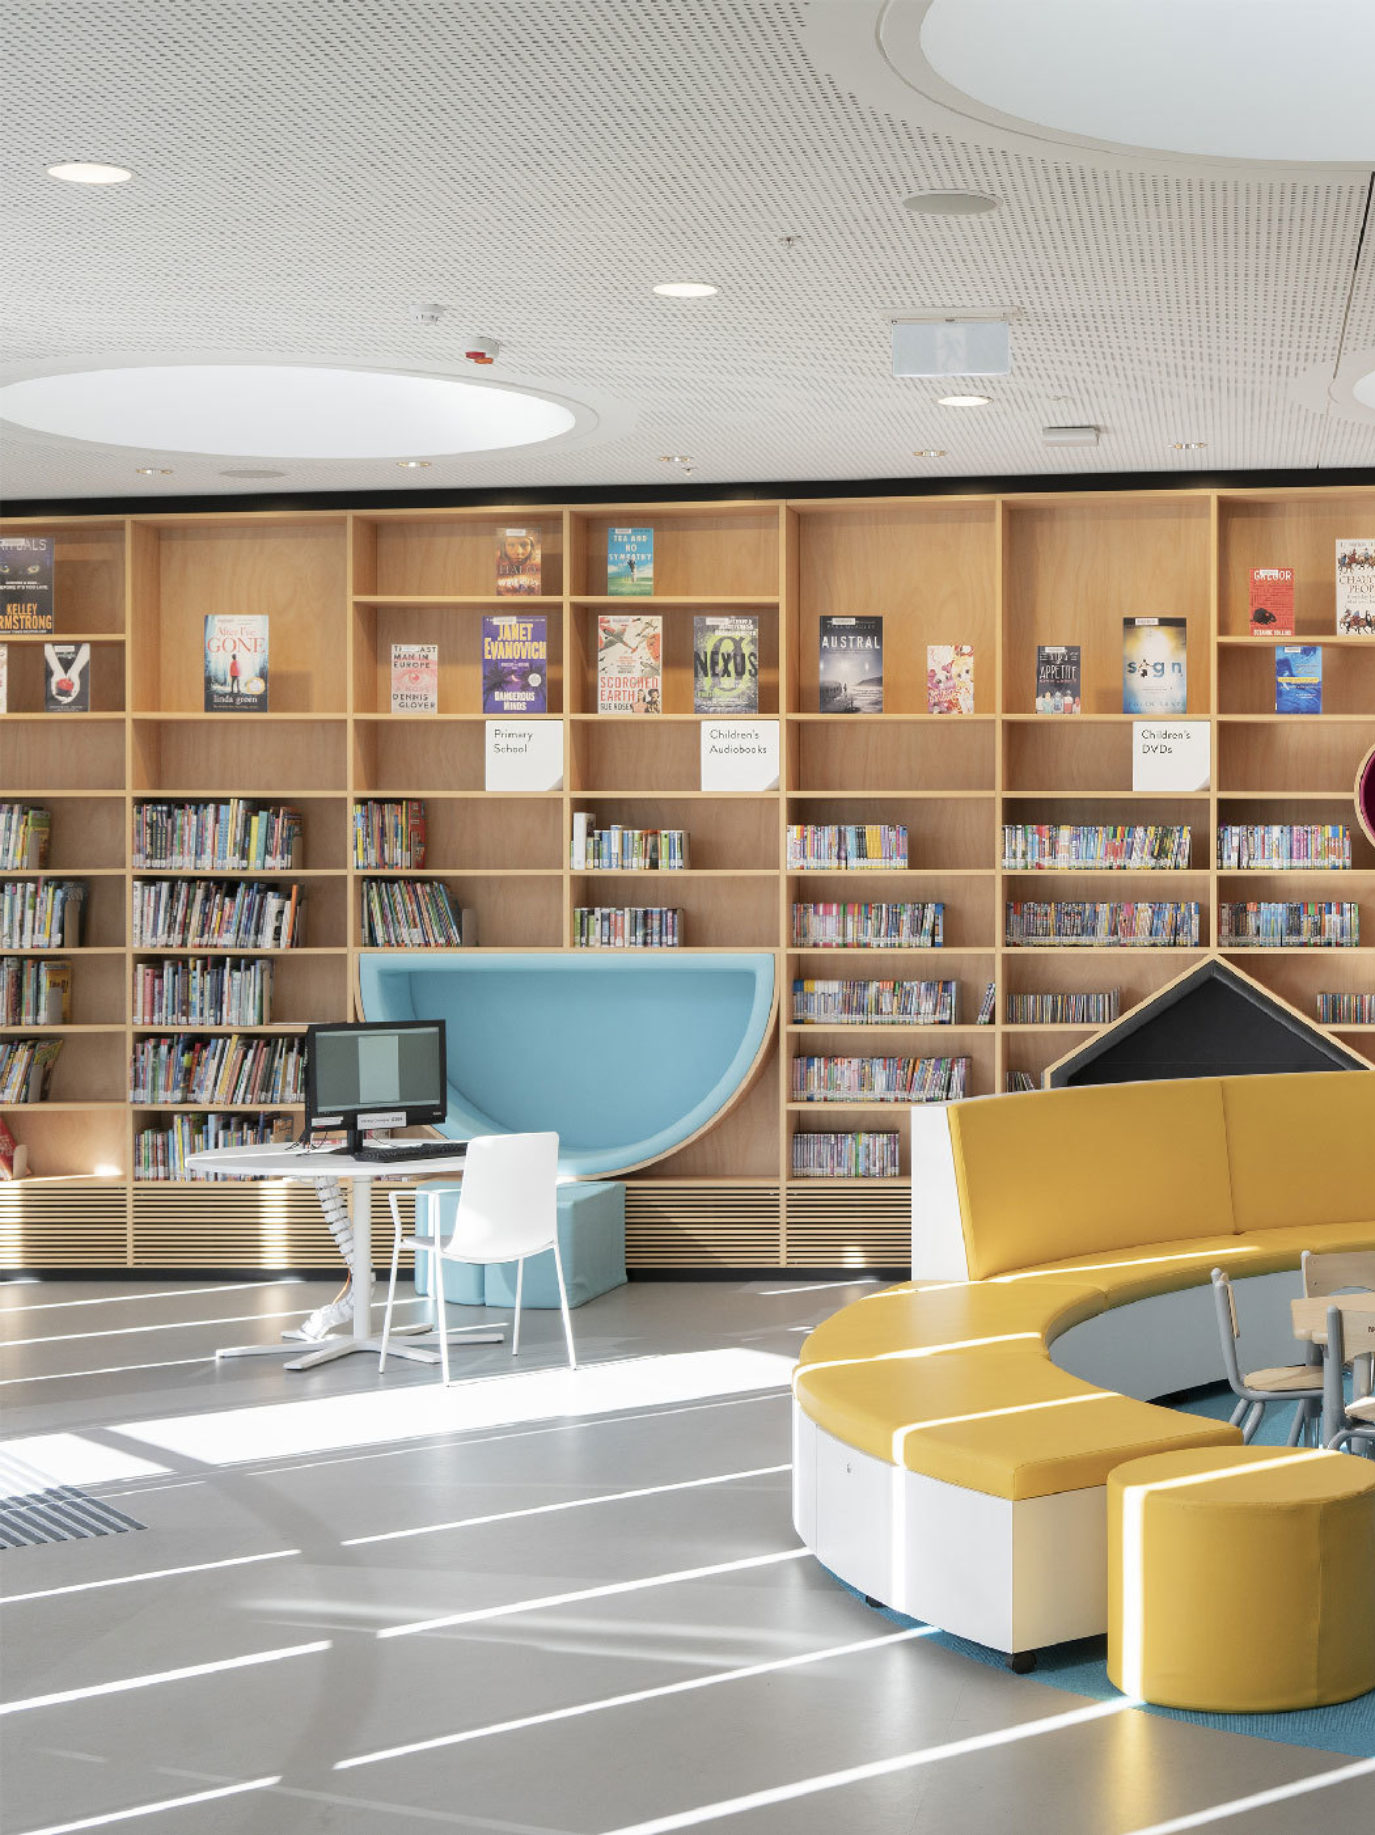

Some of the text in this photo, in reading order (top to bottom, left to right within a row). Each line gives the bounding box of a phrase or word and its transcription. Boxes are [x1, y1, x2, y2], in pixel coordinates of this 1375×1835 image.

[613, 535, 647, 543] TEA AND
[625, 544, 638, 552] NO
[6, 603, 38, 616] KELLEY
[0, 615, 52, 630] RMSTRONG
[498, 623, 534, 641] JANET
[207, 637, 266, 654] GONE
[821, 635, 881, 649] AUSTRAL
[484, 637, 547, 660] EVANOVICH
[393, 653, 429, 661] MAN IN
[393, 661, 431, 669] EUROPE
[694, 651, 759, 678] NEXUS
[600, 676, 659, 689] SCORCHED
[212, 694, 234, 703] linda
[392, 693, 429, 701] DENNIS
[494, 691, 536, 702] DANGEROUS
[600, 690, 635, 702] EARTH
[398, 701, 436, 709] GLOVER
[503, 702, 528, 711] MINDS
[600, 702, 612, 711] SUE
[494, 729, 534, 742] Primary
[709, 729, 760, 740] Children's
[1141, 729, 1191, 740] Children's
[493, 743, 528, 754] School
[709, 744, 768, 755] Audiobooks
[1142, 744, 1173, 754] DVDs
